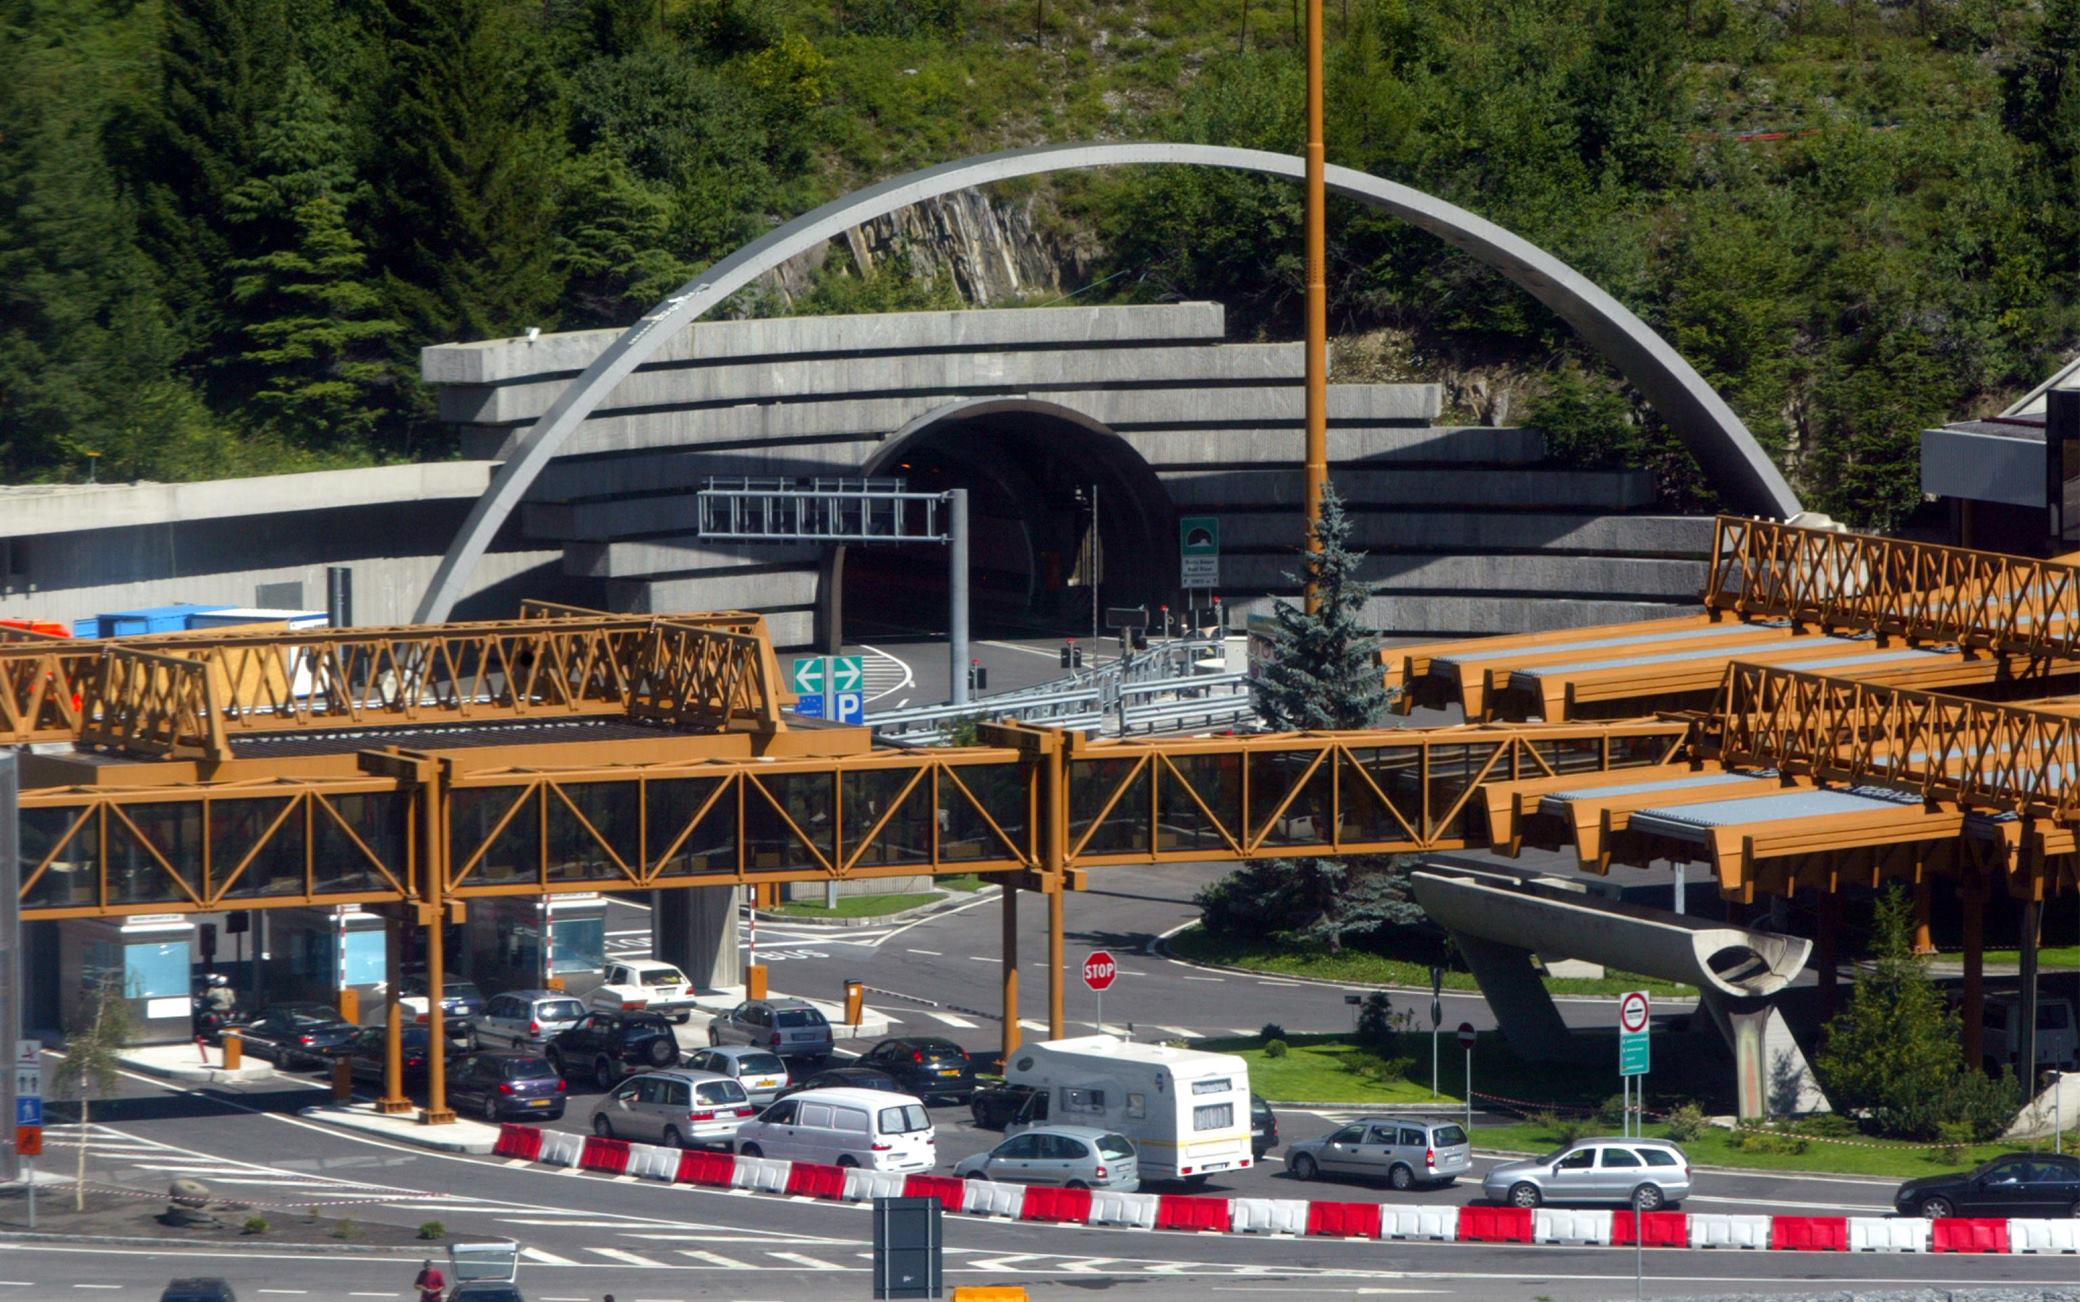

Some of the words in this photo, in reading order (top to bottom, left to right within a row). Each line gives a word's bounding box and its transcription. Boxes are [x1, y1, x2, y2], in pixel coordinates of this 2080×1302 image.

[838, 693, 860, 723] P
[752, 948, 830, 961] BUS
[1085, 962, 1114, 979] STOP
